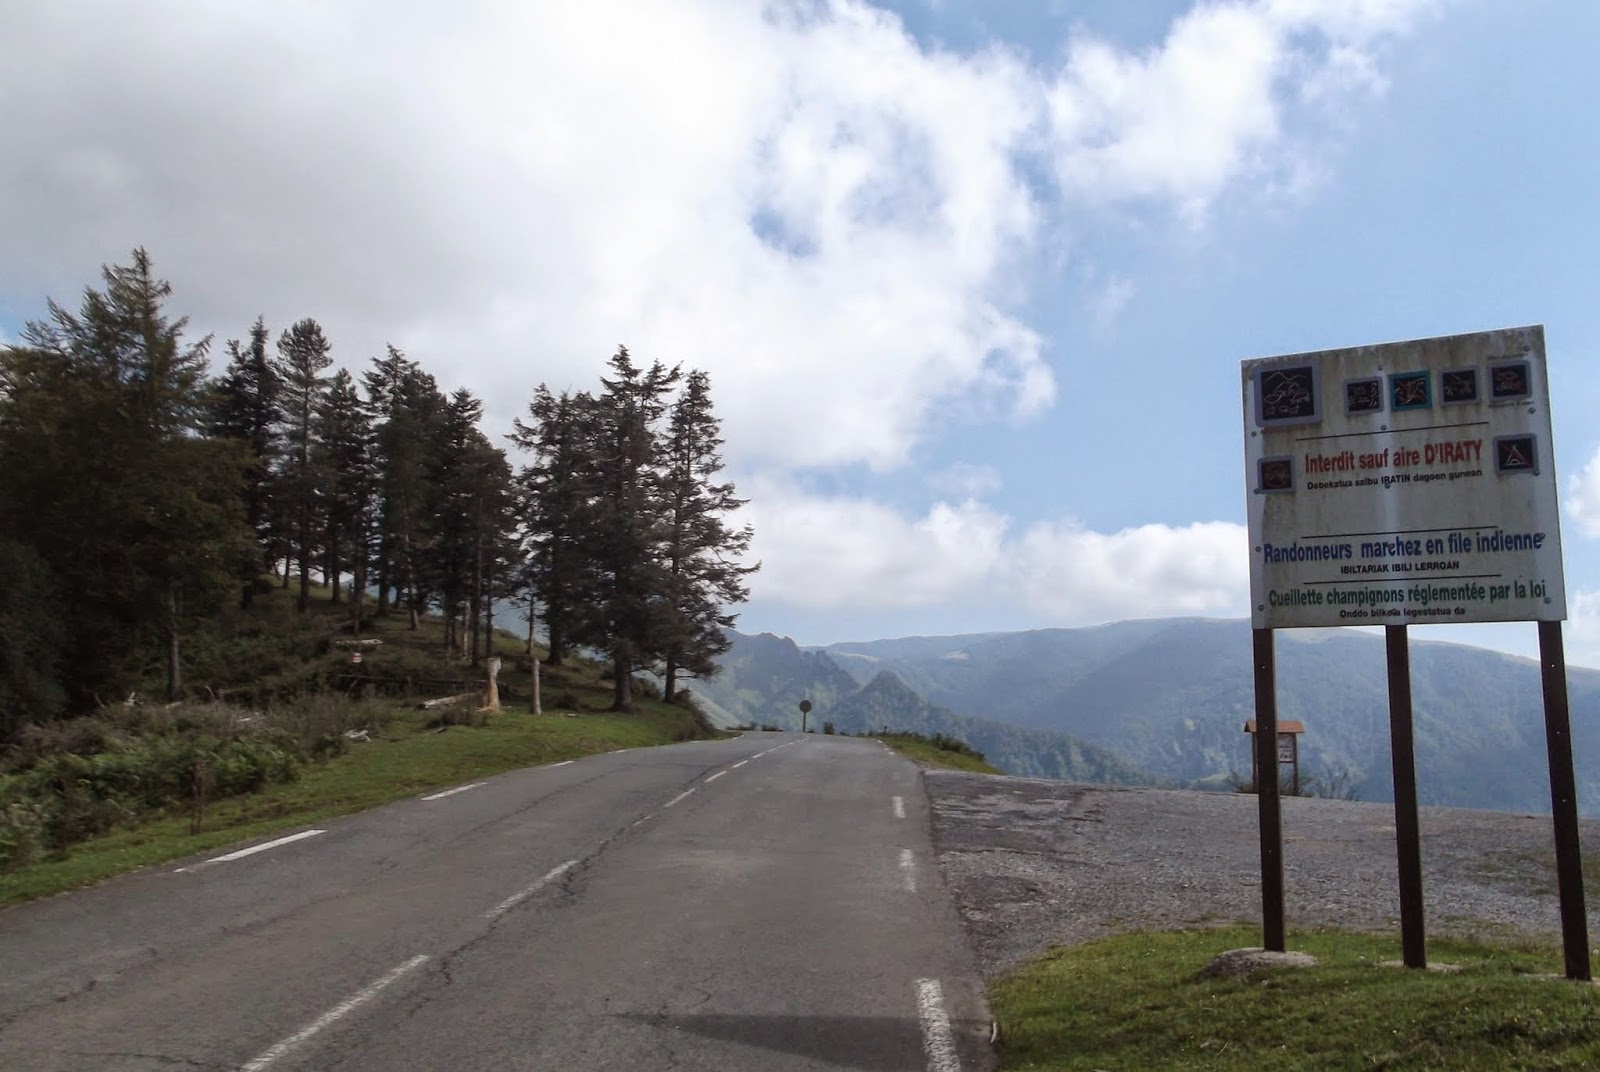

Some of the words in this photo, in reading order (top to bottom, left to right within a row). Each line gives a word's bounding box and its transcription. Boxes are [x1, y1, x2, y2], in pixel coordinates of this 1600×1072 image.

[1305, 450, 1355, 474] Interdit
[1359, 447, 1389, 469] sauf
[1393, 446, 1420, 467] aire
[1424, 439, 1483, 466] D'IRATY
[1355, 477, 1379, 486] salbu
[1413, 473, 1447, 482] dagoen
[1449, 469, 1483, 480] gunean
[1263, 541, 1353, 563] Randonneurs
[1361, 536, 1422, 558] marchez
[1425, 538, 1444, 555] en
[1448, 532, 1472, 553] file
[1476, 530, 1544, 552] indienne
[1341, 563, 1389, 575] IBILTARIAK
[1391, 562, 1413, 573] IBILI
[1415, 560, 1460, 571] LERROAN
[1268, 588, 1323, 607] Cueillette
[1326, 586, 1404, 607] champignons
[1407, 582, 1486, 606] réglementée
[1489, 584, 1511, 603] par
[1514, 580, 1526, 599] la
[1530, 578, 1547, 598] loi
[1340, 609, 1369, 618] Onddo
[1454, 605, 1466, 615] da
